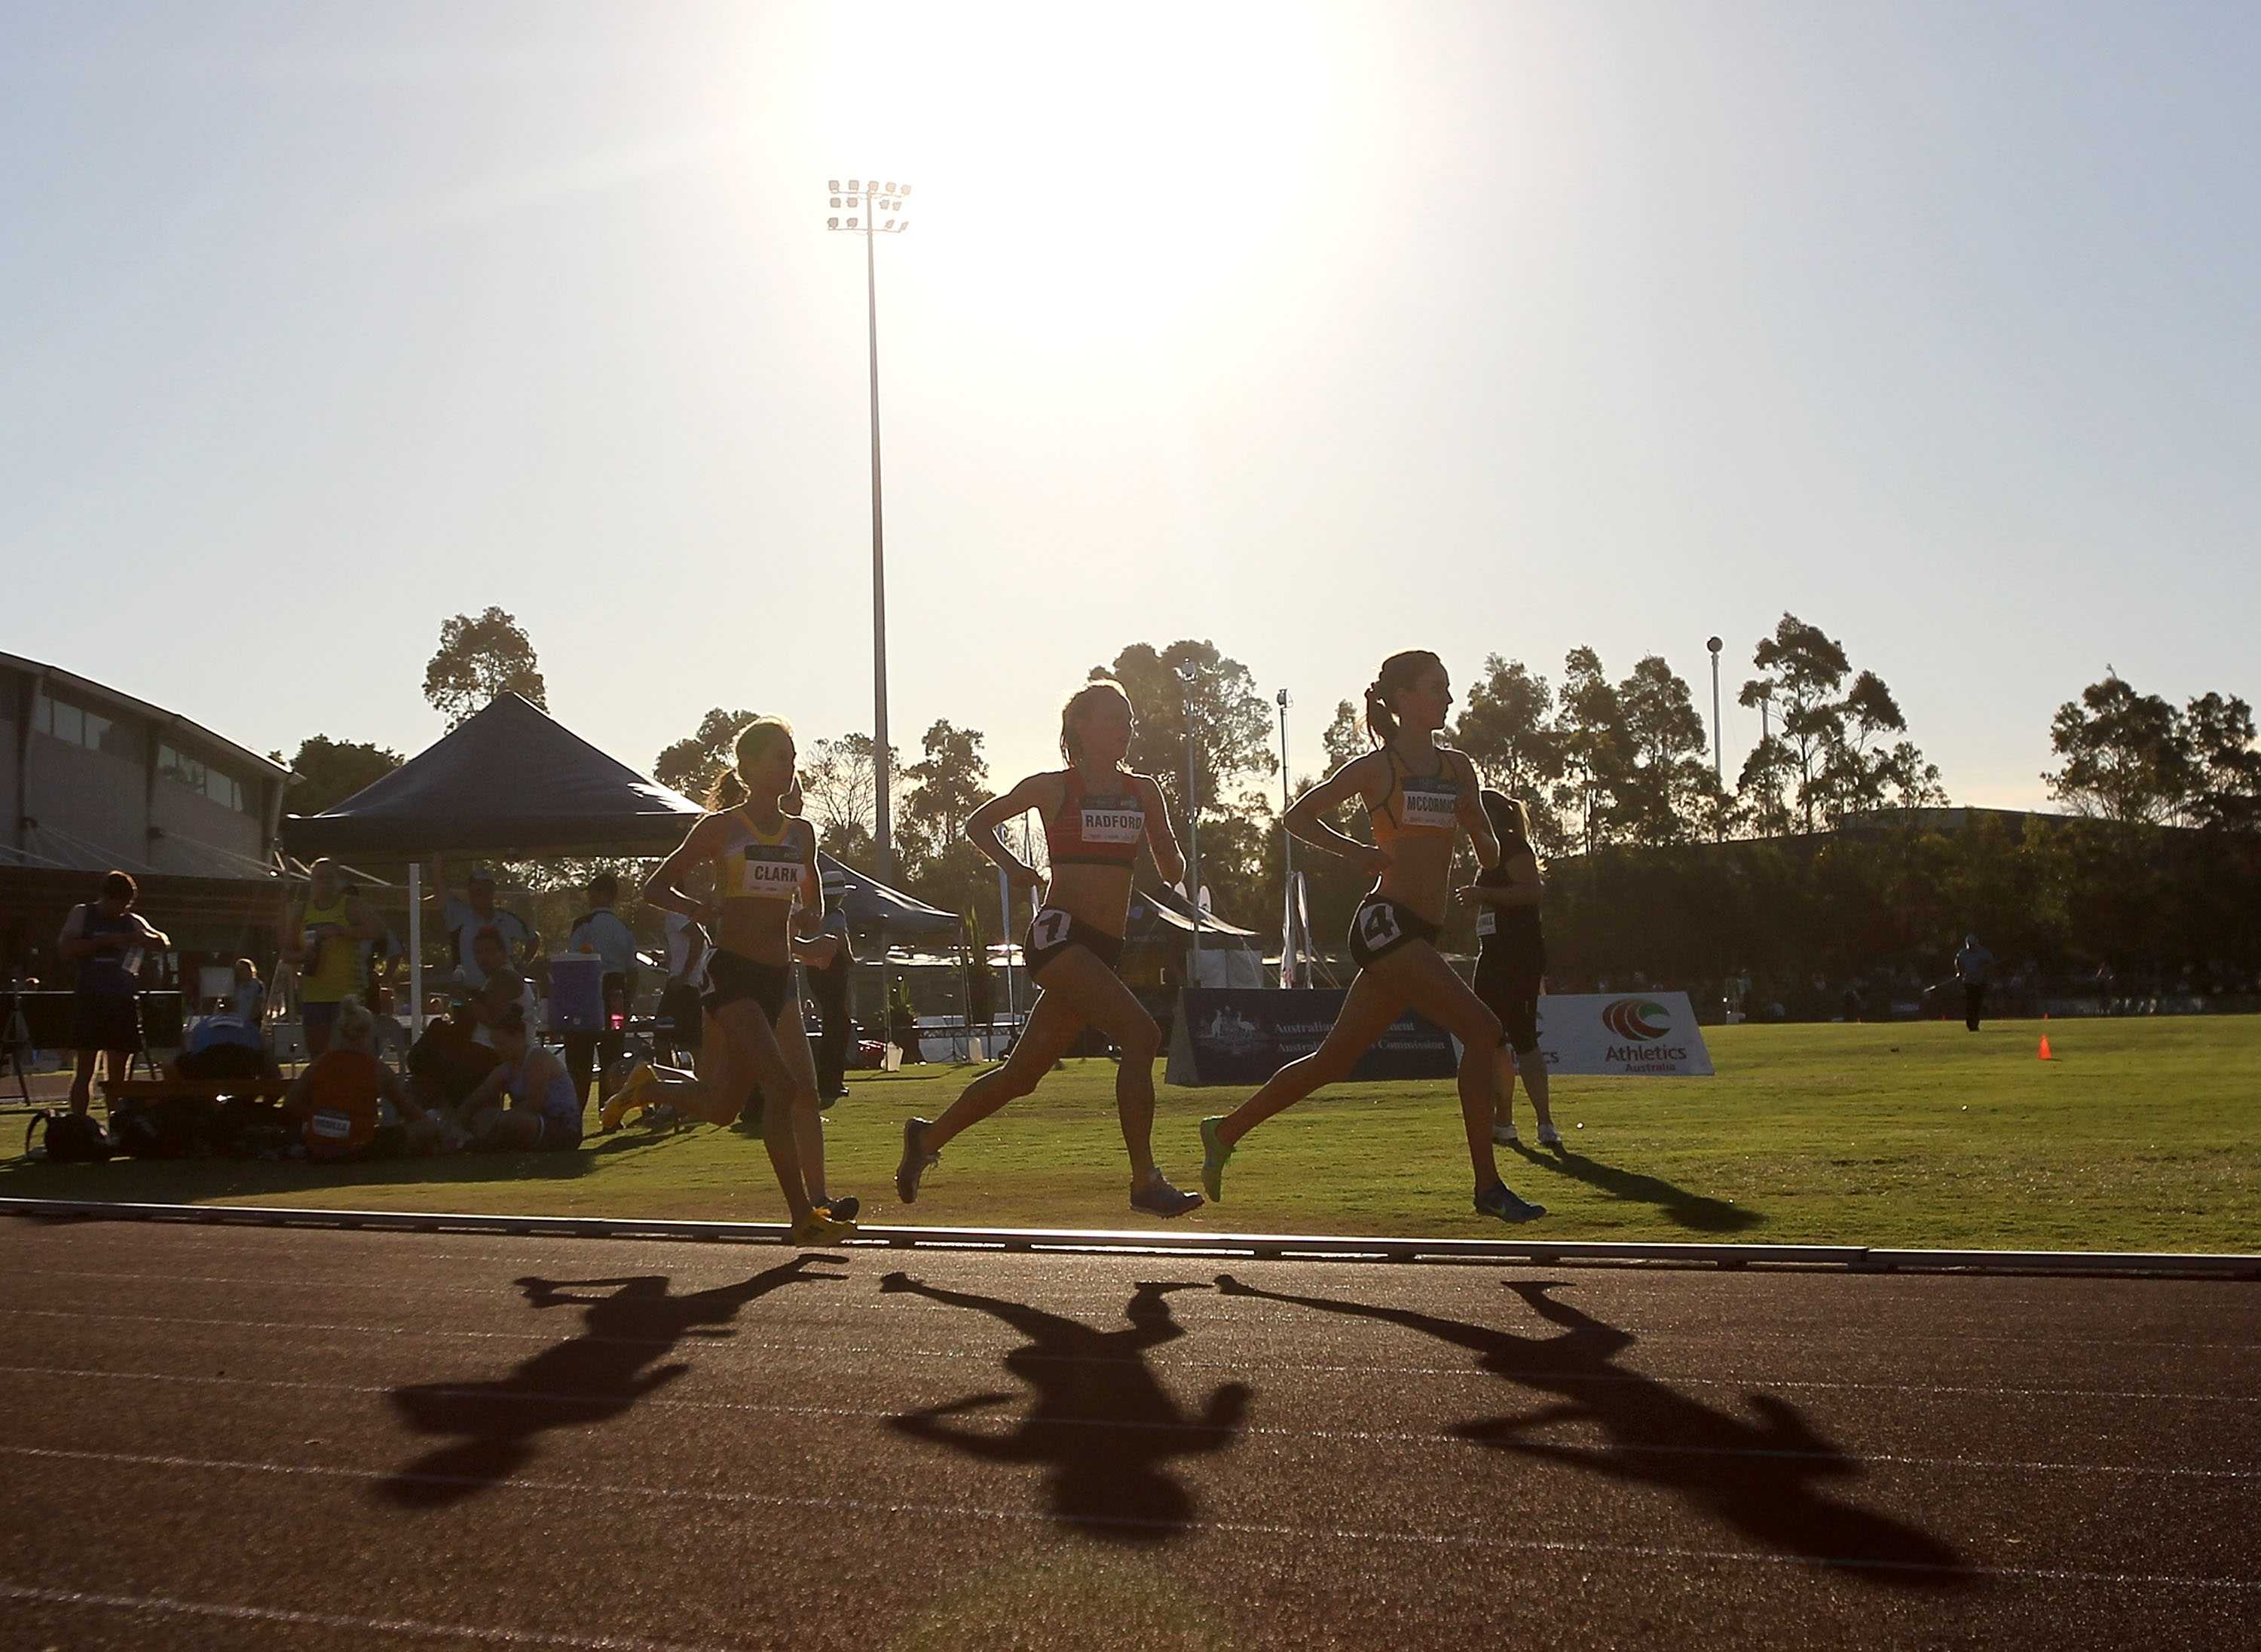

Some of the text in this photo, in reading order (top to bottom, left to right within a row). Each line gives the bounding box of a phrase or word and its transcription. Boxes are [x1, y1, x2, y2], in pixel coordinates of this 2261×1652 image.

[1407, 795, 1455, 814] MCCORMIC
[1085, 815, 1142, 830] RADFORD
[754, 865, 797, 882] CLARK
[1039, 912, 1063, 943] 7
[1364, 905, 1394, 942] 4
[1377, 1039, 1446, 1050] Commission
[1605, 1044, 1687, 1062] Athletics
[1625, 1063, 1676, 1072] Australia
